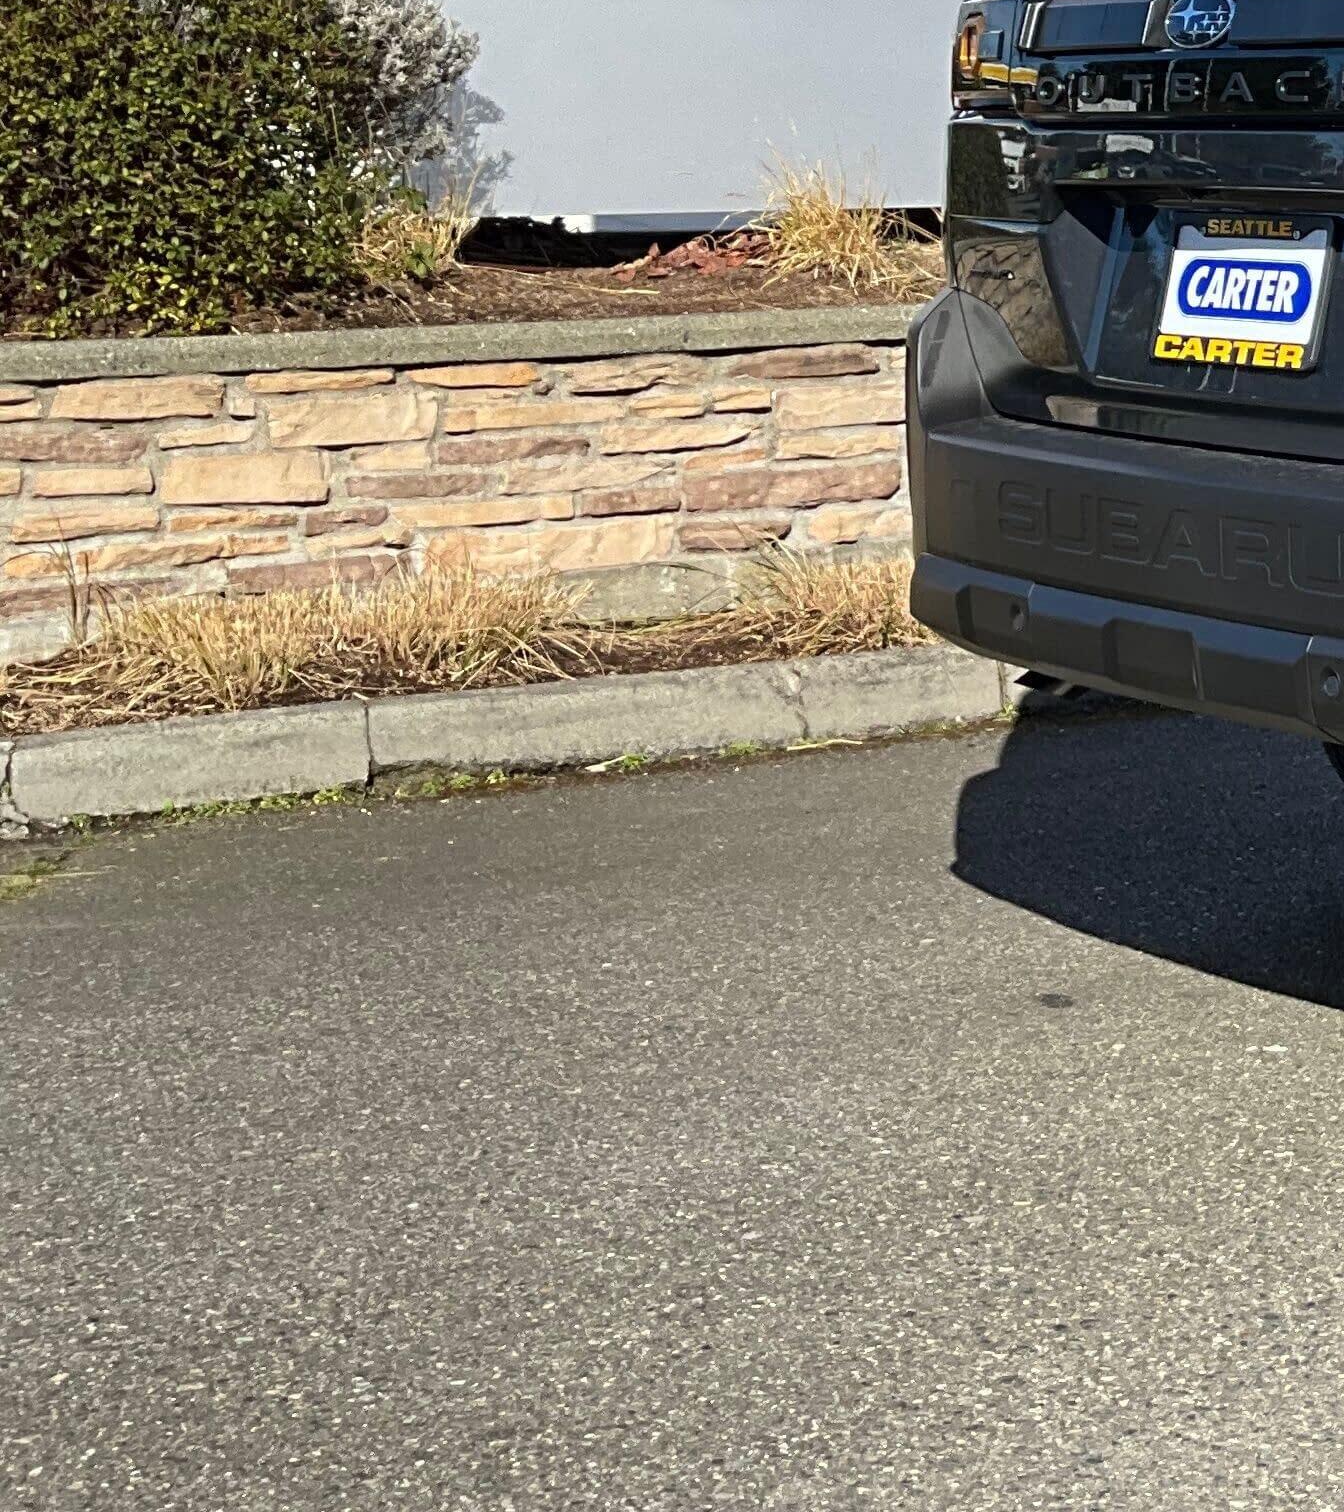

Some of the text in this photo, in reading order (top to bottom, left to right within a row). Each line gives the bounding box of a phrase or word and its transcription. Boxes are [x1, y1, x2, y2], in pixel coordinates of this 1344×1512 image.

[1207, 219, 1293, 237] SEATTLE
[1186, 265, 1300, 314] CARTER
[1154, 334, 1305, 369] CARTER
